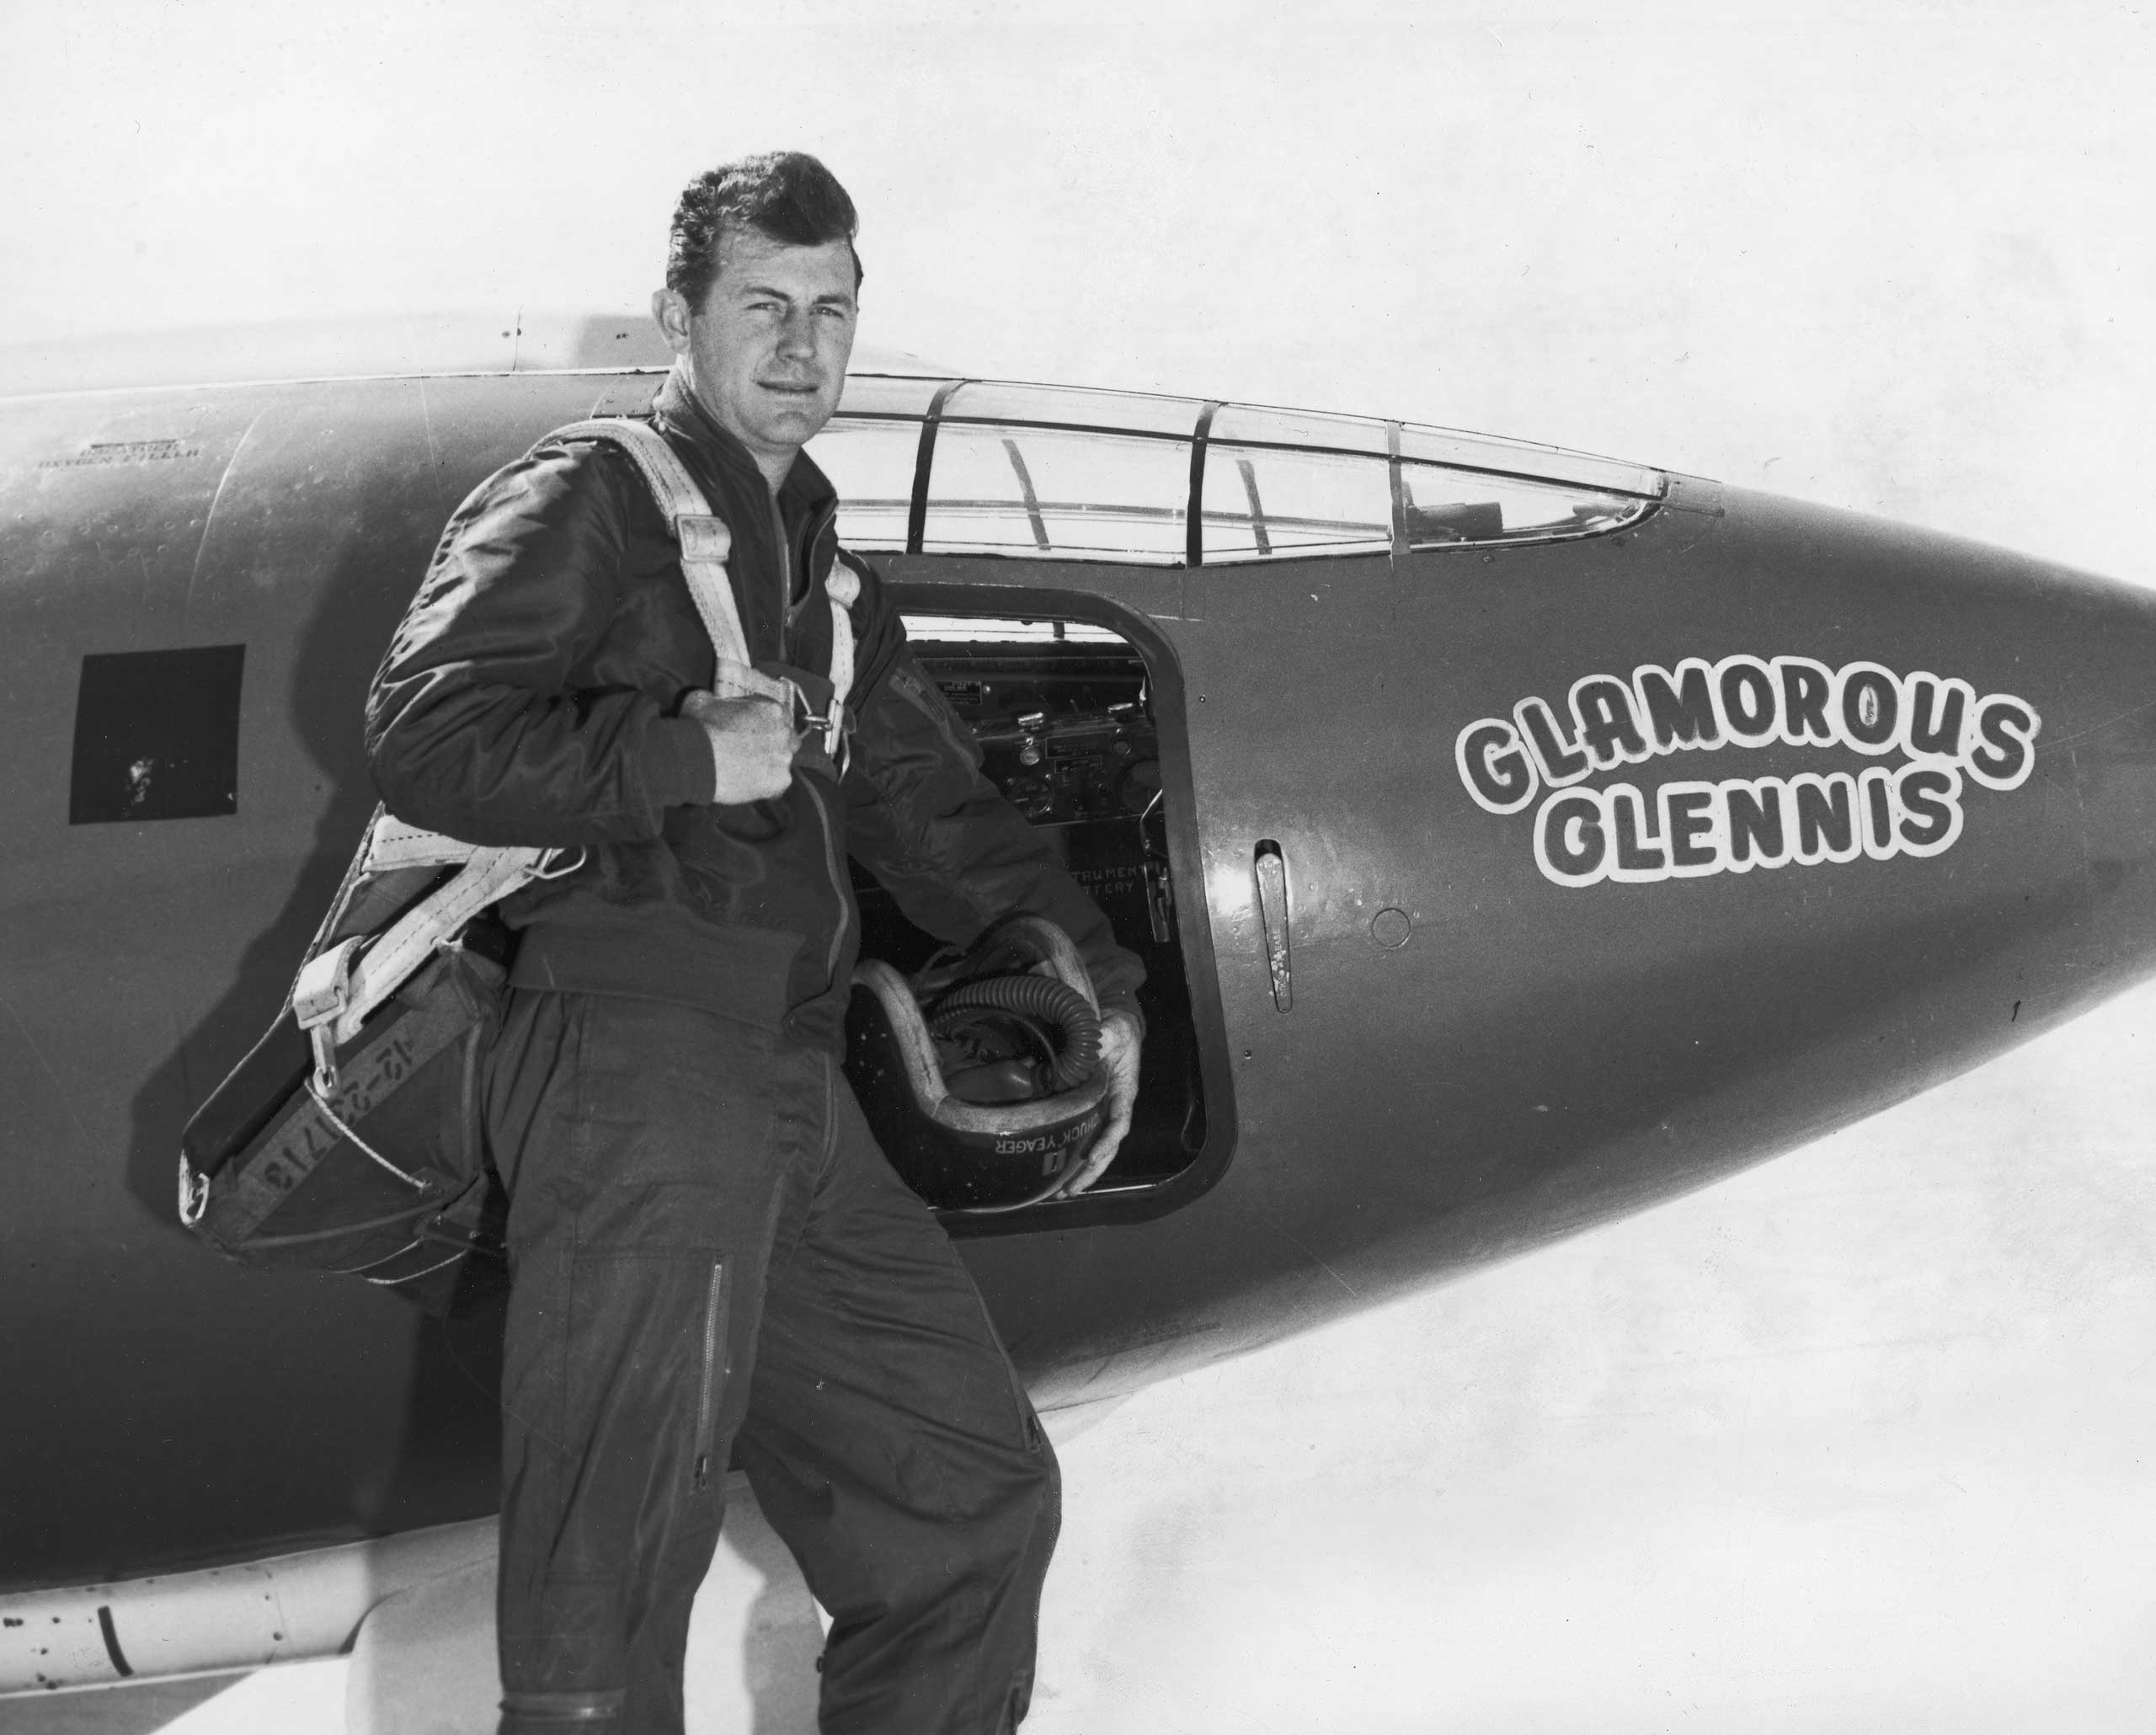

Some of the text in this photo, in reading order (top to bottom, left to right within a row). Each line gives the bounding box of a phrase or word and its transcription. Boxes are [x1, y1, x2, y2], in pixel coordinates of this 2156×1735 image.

[1455, 654, 2041, 814] GLAMOROUS
[1533, 761, 1965, 888] GLENNIS
[1071, 864, 1146, 884] TRUMENT
[1082, 881, 1134, 896] TTERY
[995, 1134, 1057, 1155] YEAGER
